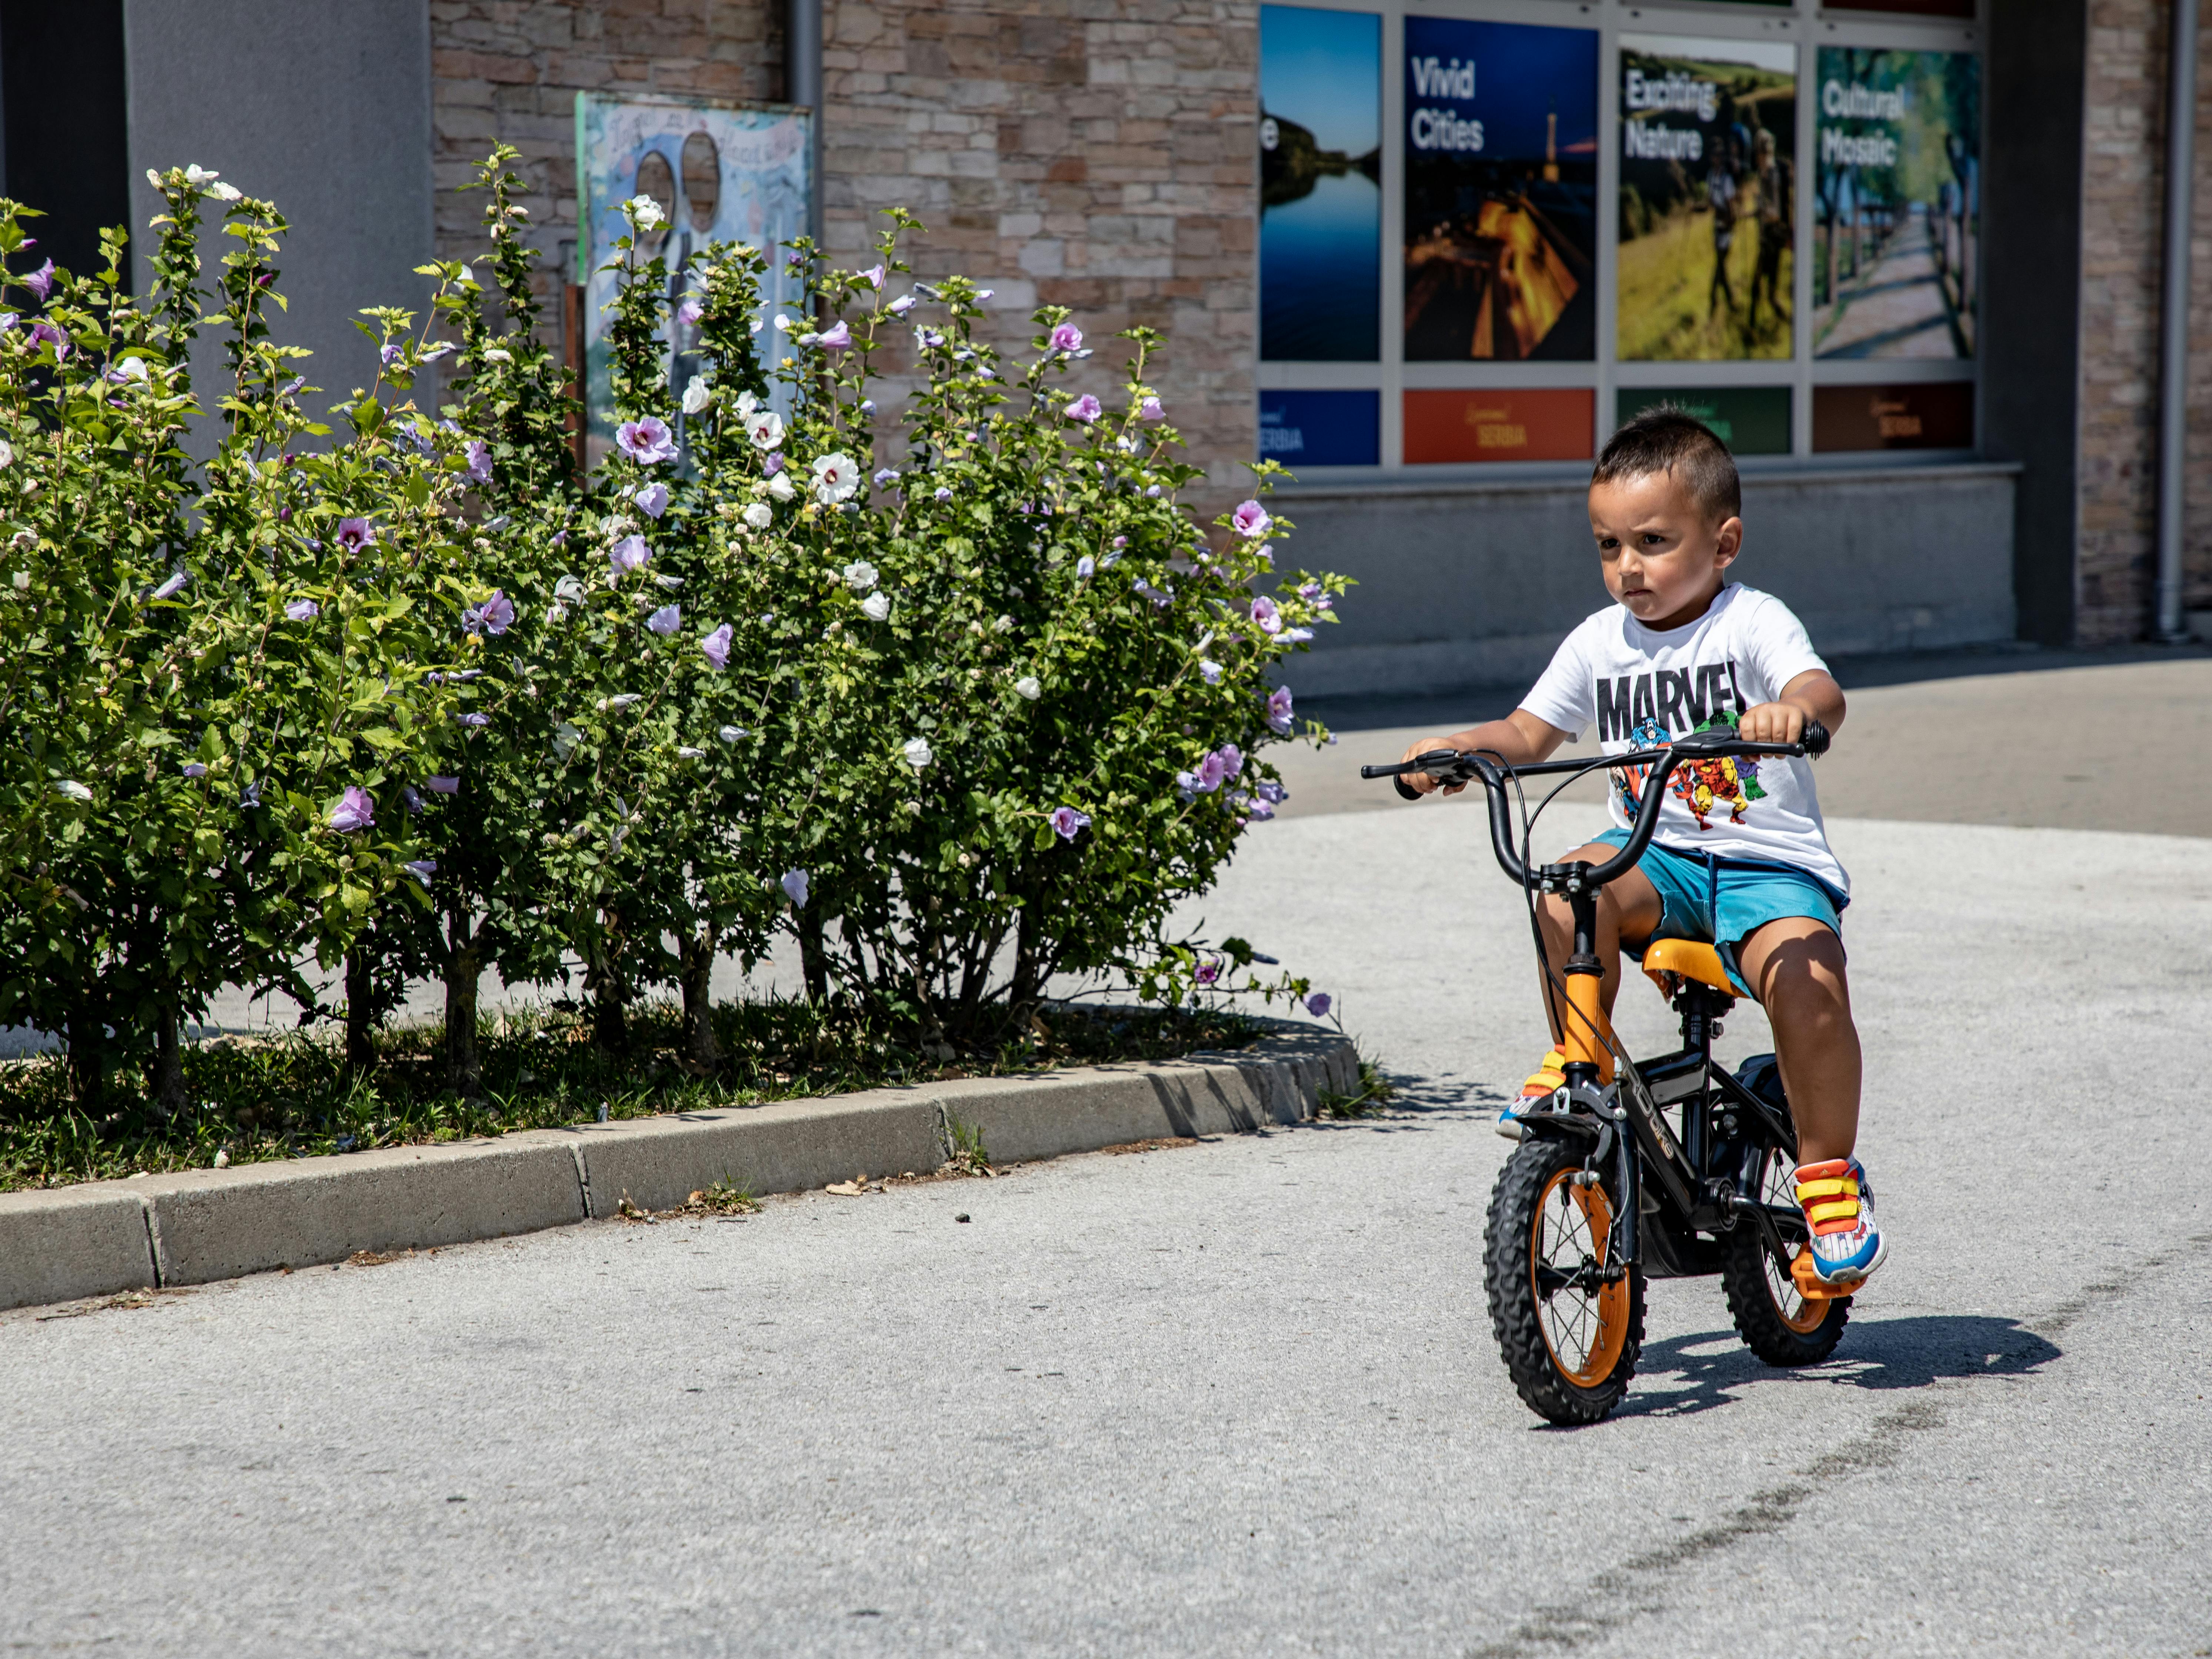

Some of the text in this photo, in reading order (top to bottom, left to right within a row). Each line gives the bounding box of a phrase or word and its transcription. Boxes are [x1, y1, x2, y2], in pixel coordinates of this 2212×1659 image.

[1411, 56, 1475, 99] Vivid
[1625, 69, 1716, 121] Exciting
[1823, 79, 1905, 120] Cultural
[1411, 107, 1484, 151] Cities
[1625, 120, 1702, 160] Nature
[1822, 129, 1896, 166] Mosaic
